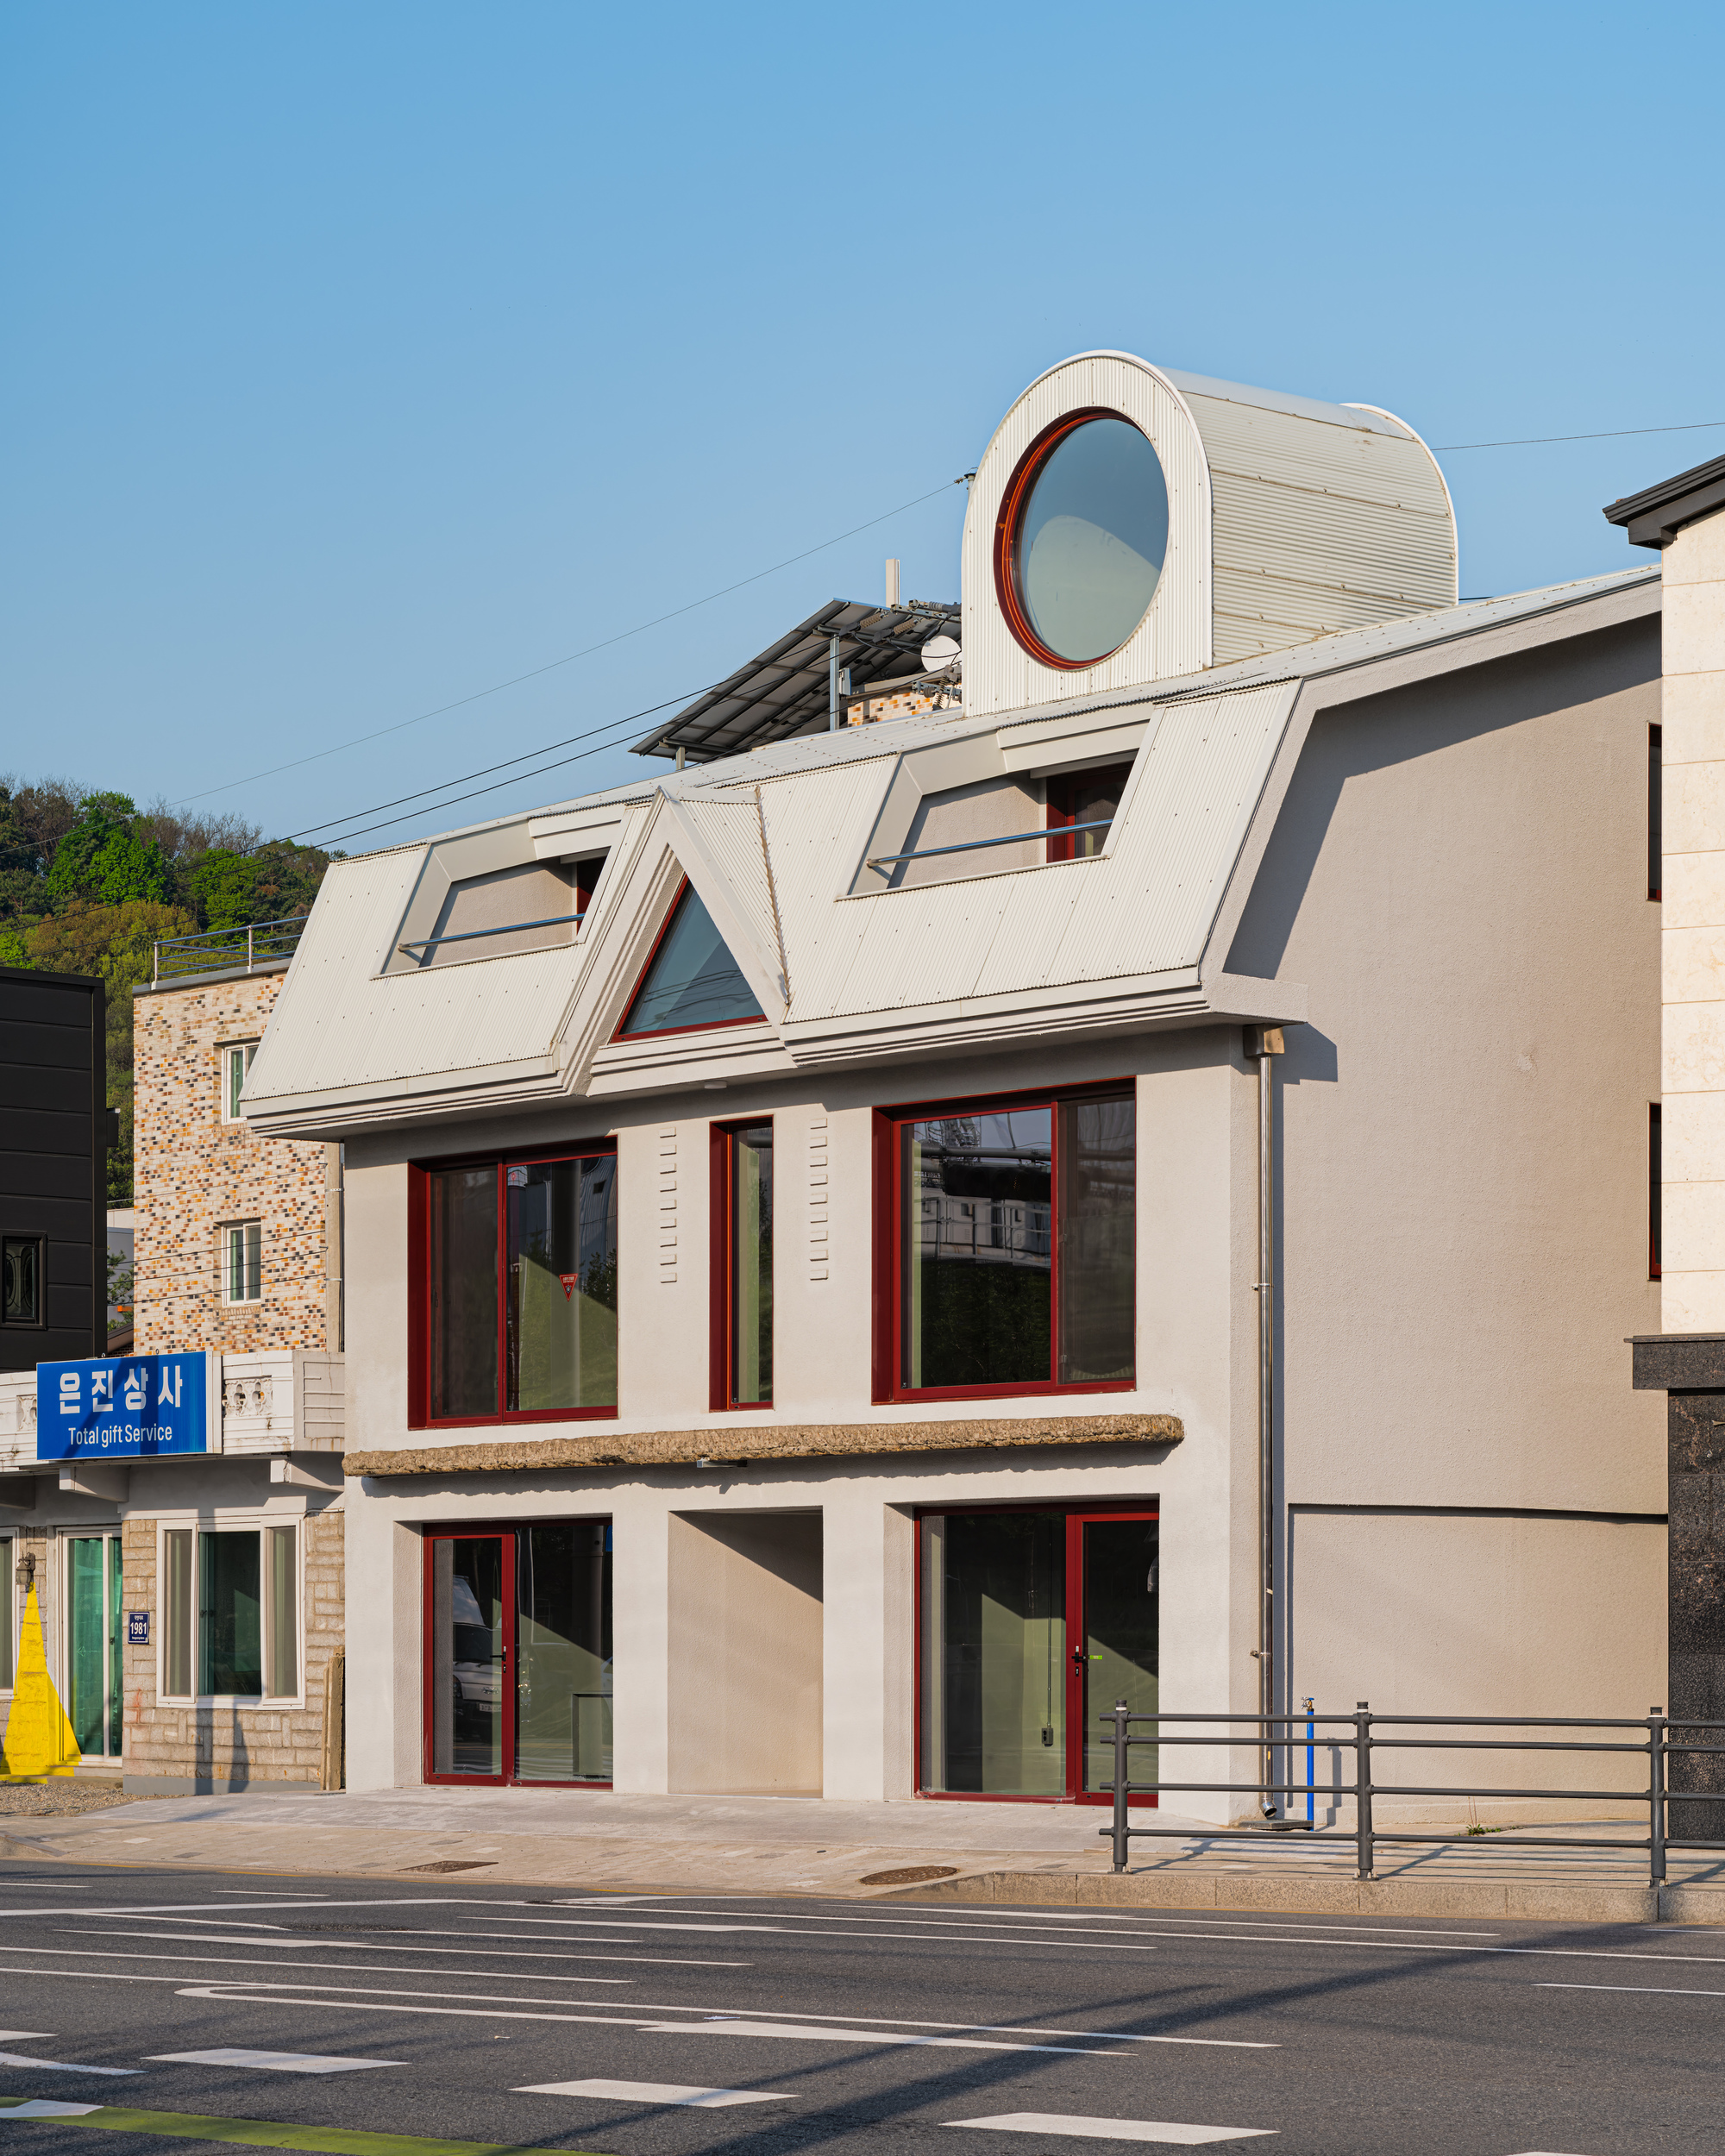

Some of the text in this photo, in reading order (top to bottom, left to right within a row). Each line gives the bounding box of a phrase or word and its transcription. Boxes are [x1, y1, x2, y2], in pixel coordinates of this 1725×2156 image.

[60, 1365, 183, 1414] 은진상사
[68, 1423, 172, 1448] Total gift Service
[130, 1622, 147, 1635] 1981
